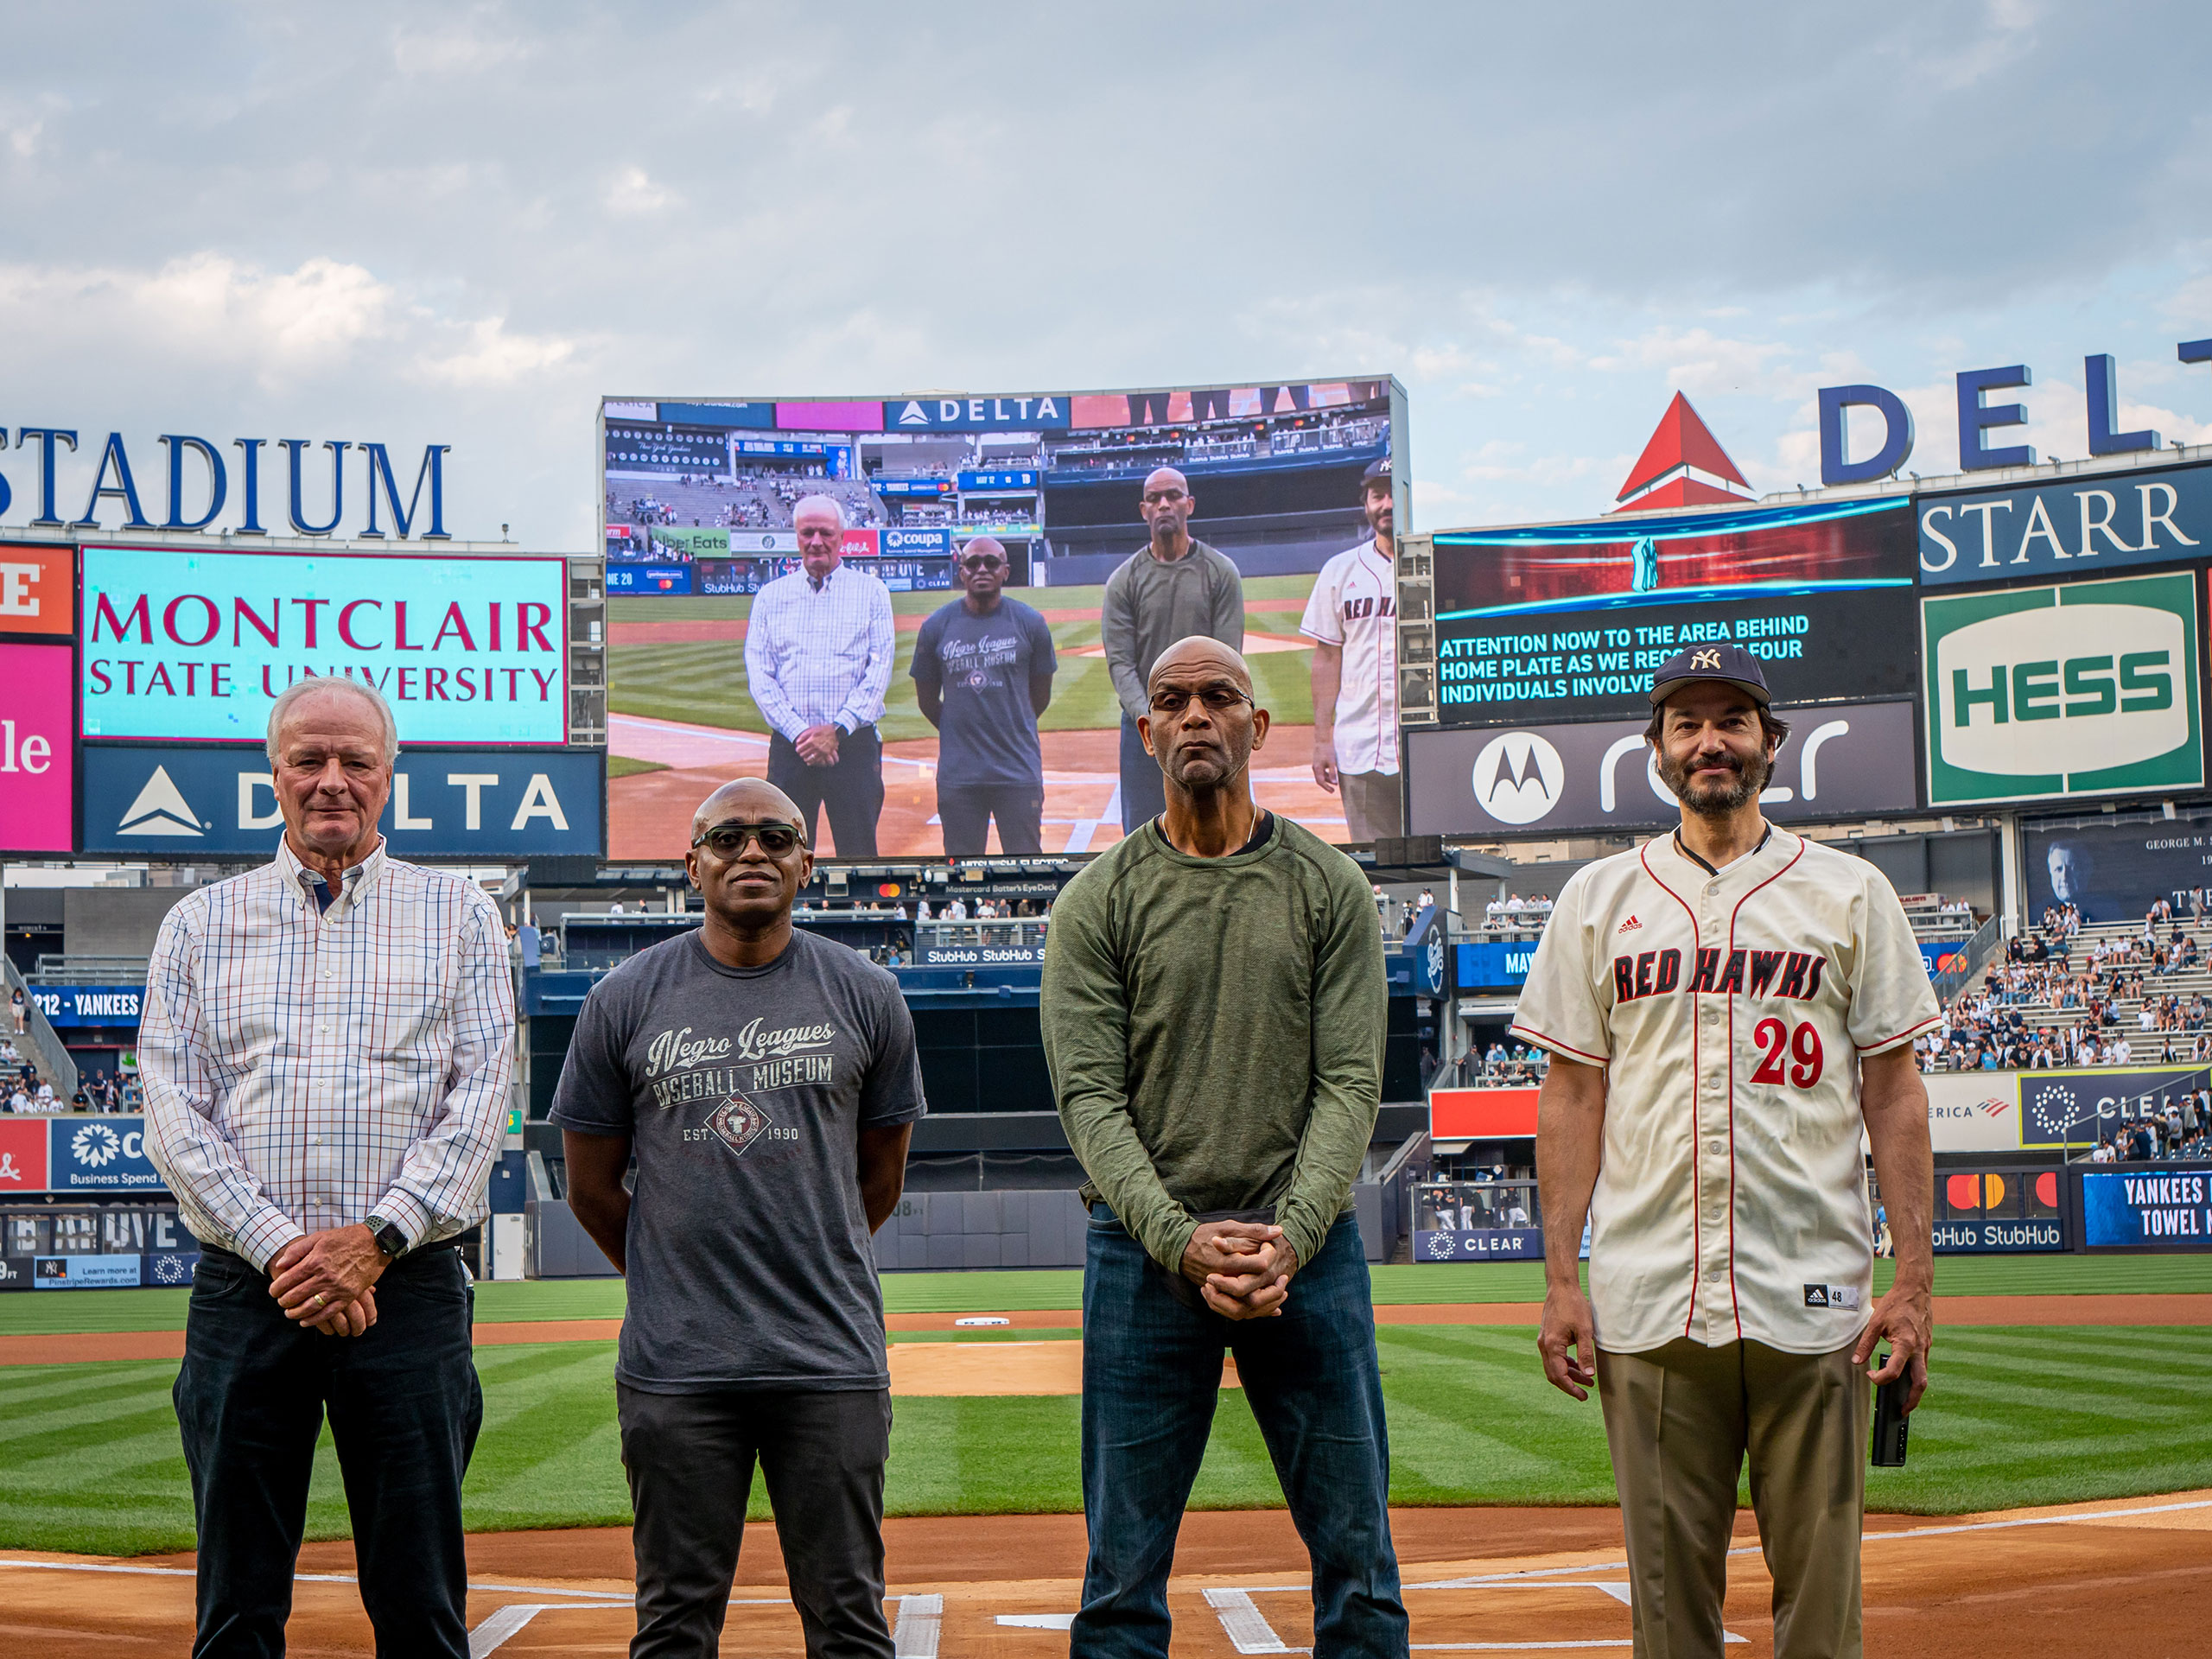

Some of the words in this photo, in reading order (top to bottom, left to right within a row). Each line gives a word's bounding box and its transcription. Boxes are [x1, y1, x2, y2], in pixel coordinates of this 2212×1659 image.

[940, 397, 1058, 422] DELTA
[1920, 482, 2200, 572] STARR
[693, 536, 728, 549] Eats
[904, 533, 943, 547] coupa
[621, 573, 632, 585] 20
[705, 583, 745, 594] StubHub
[1344, 597, 1374, 620] RED
[91, 592, 556, 652] MONTCLAIR
[1440, 635, 1546, 658] ATTENTION
[1553, 630, 1600, 651] NOW
[1605, 628, 1630, 648] TO
[1636, 626, 1675, 646] THE
[1679, 621, 1731, 643] AREA
[1736, 615, 1809, 639] BEHIND
[1440, 660, 1497, 681] HOME
[1503, 656, 1562, 677] PLATE
[1567, 654, 1592, 673] AS
[1598, 651, 1630, 671] WE
[1748, 639, 1802, 660] FOUR
[90, 658, 232, 698] STATE
[1952, 650, 2173, 728] HESS
[1441, 679, 1567, 704] INDIVIDUALS
[238, 772, 569, 830] DLTA
[2145, 837, 2190, 850] GEORGE
[2193, 836, 2205, 847] M.
[946, 885, 990, 893] Mastercard
[993, 884, 1021, 893] Batter's
[1023, 884, 1036, 893] Eye
[1037, 883, 1057, 892] Deck
[1618, 922, 1643, 934] adidas
[928, 950, 977, 963] StubHub
[982, 949, 1033, 962] StubHub
[1614, 947, 1681, 1004] RED
[1687, 947, 1827, 1001] HAWKS
[74, 994, 139, 1016] YANKEES
[645, 1027, 732, 1077] Negro
[738, 1017, 836, 1060] Leagues
[1750, 1017, 1824, 1089] 29
[753, 1057, 833, 1090] MUSEUM
[683, 1128, 713, 1141] EST.
[768, 1128, 798, 1140] 1990
[70, 1173, 118, 1185] Business
[122, 1173, 157, 1186] Spend
[2125, 1177, 2202, 1205] YANKEES
[2141, 1209, 2200, 1236] TOWEL
[1465, 1237, 1522, 1251] CLEAR
[1984, 1225, 2060, 1246] StubHub
[49, 1276, 137, 1287] PinstripeRewards.com
[1832, 1291, 1842, 1302] 48
